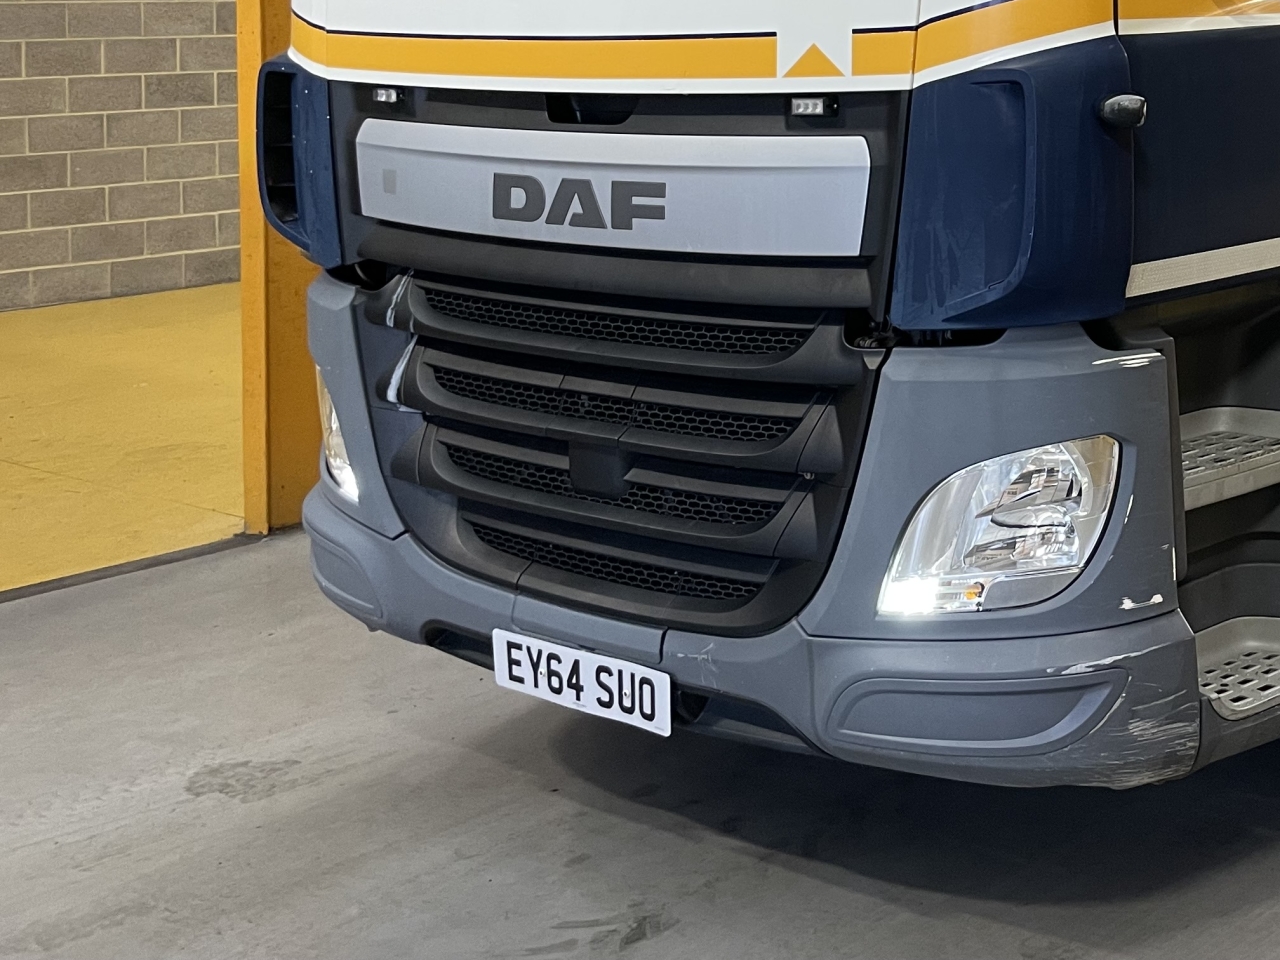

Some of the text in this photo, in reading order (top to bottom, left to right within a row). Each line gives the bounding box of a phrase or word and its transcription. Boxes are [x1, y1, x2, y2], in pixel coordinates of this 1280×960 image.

[492, 172, 666, 230] DAF
[506, 640, 656, 722] EY64 SUO
